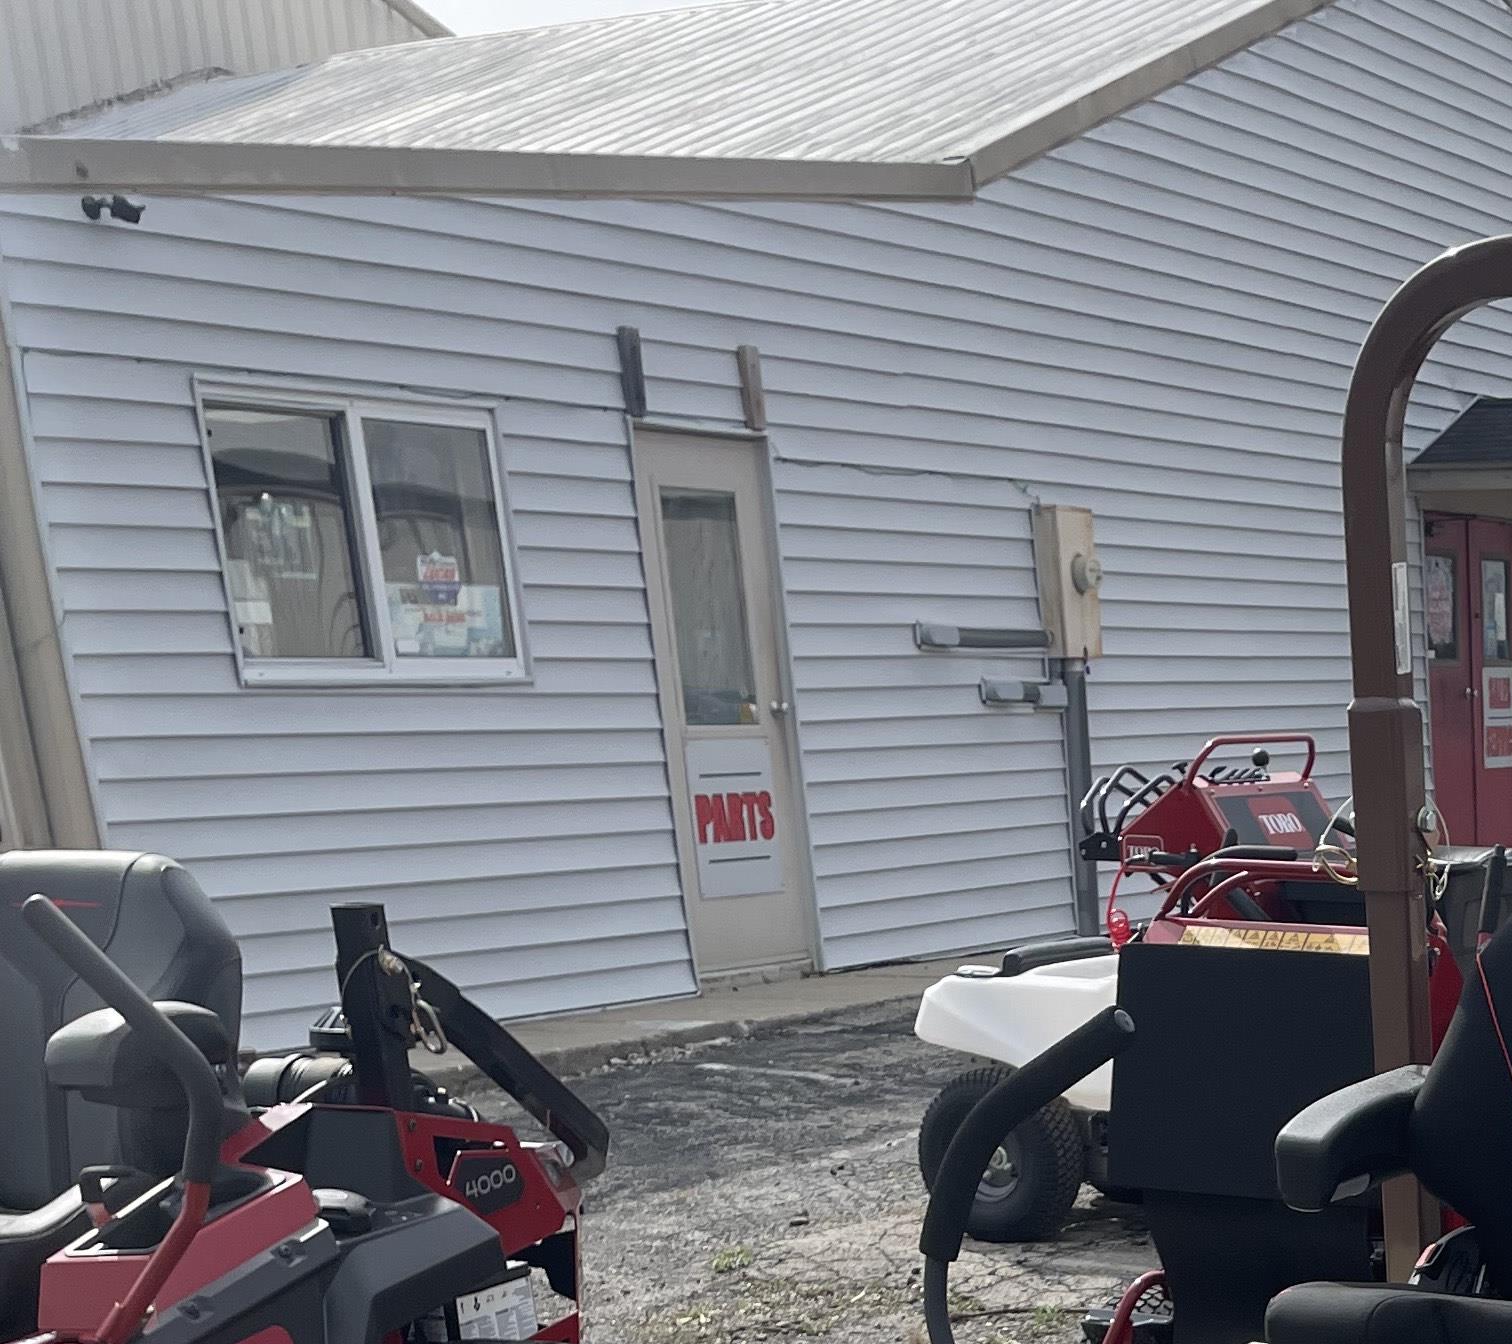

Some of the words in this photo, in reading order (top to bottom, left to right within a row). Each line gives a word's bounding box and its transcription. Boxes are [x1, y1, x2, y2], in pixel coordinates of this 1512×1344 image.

[695, 791, 774, 844] PARTS
[1258, 813, 1303, 834] TORO
[465, 1165, 516, 1198] 4000
